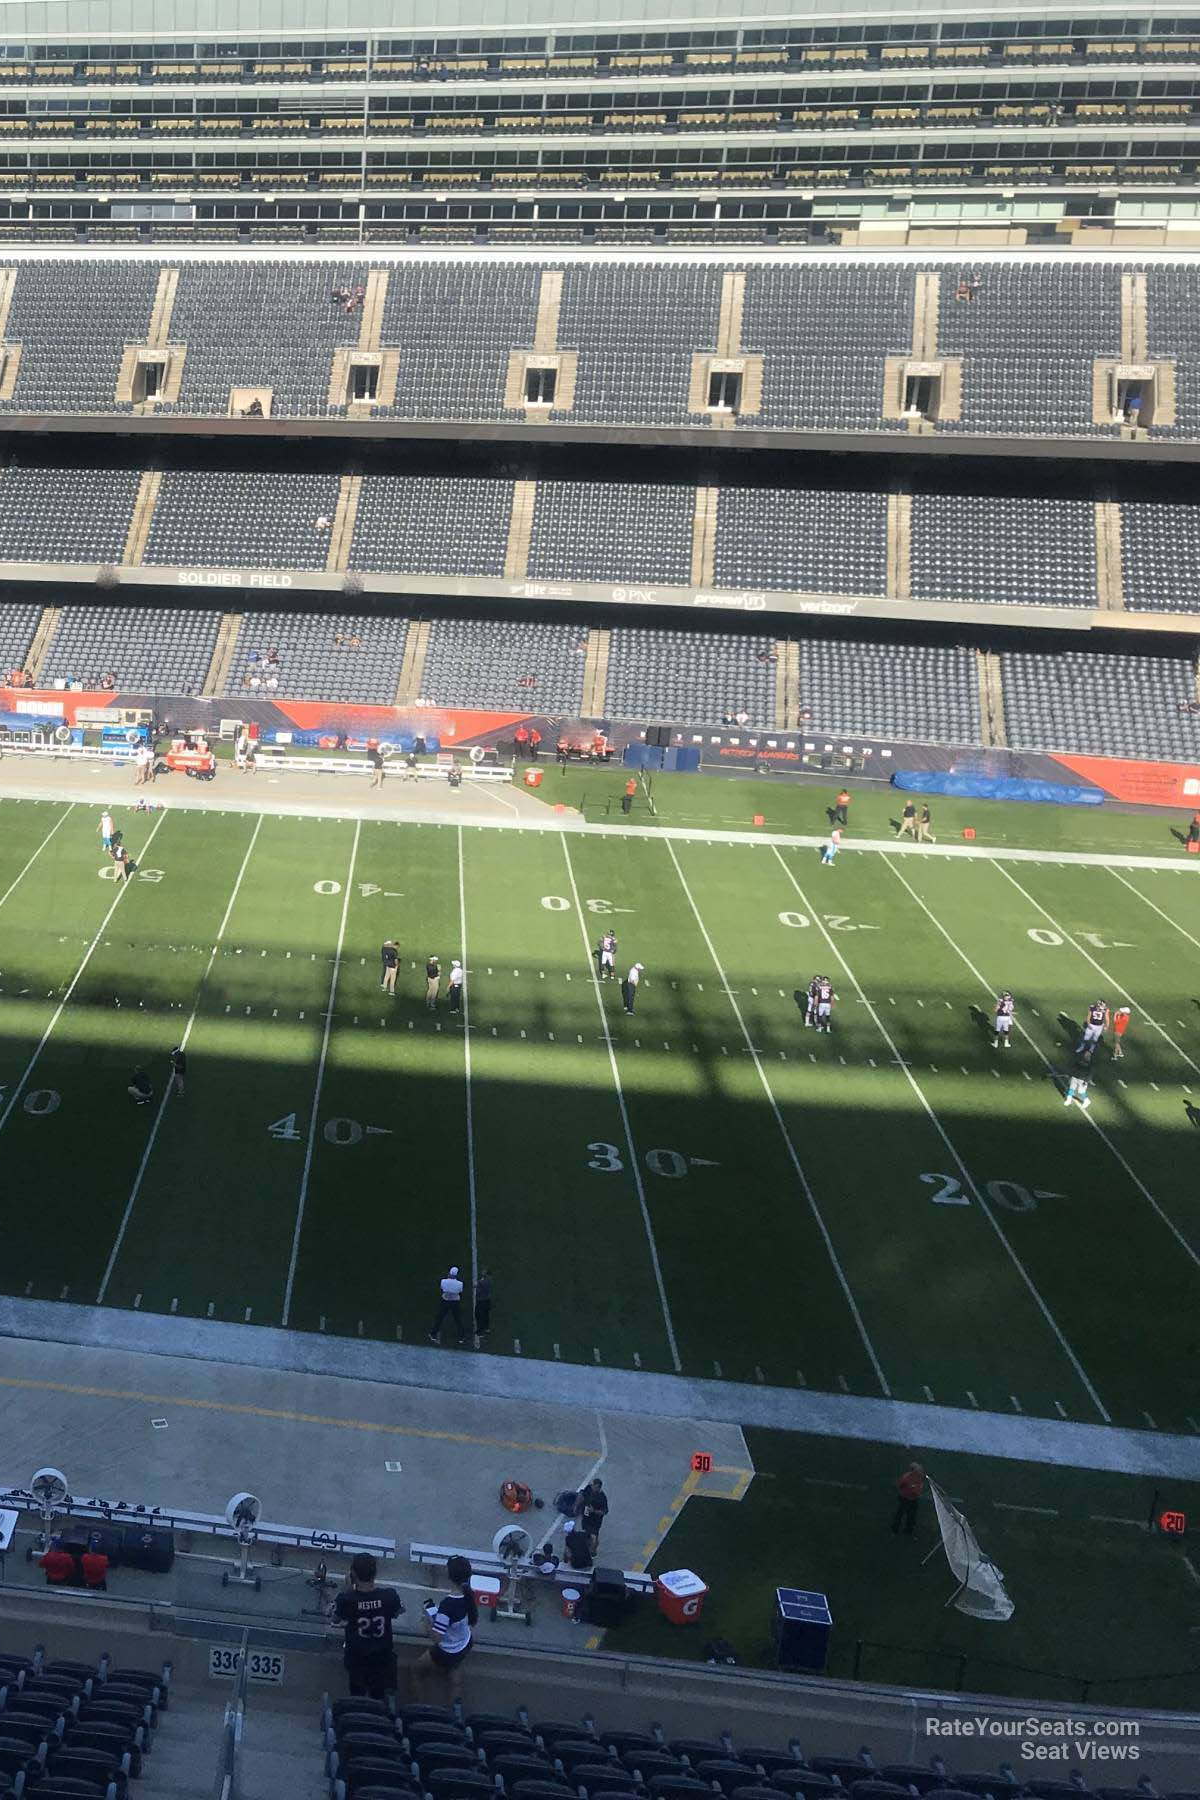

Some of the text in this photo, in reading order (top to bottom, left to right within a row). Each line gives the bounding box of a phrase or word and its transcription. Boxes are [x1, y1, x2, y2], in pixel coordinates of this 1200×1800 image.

[178, 572, 292, 587] SOLDIER FIELD
[628, 589, 657, 601] PNC
[799, 601, 854, 614] verizon
[694, 1455, 710, 1471] 30
[1166, 1514, 1184, 1531] 20
[358, 1600, 382, 1610] HESTER
[479, 1595, 490, 1605] G
[683, 1600, 698, 1616] G
[357, 1616, 386, 1638] 23
[251, 1655, 282, 1676] 335
